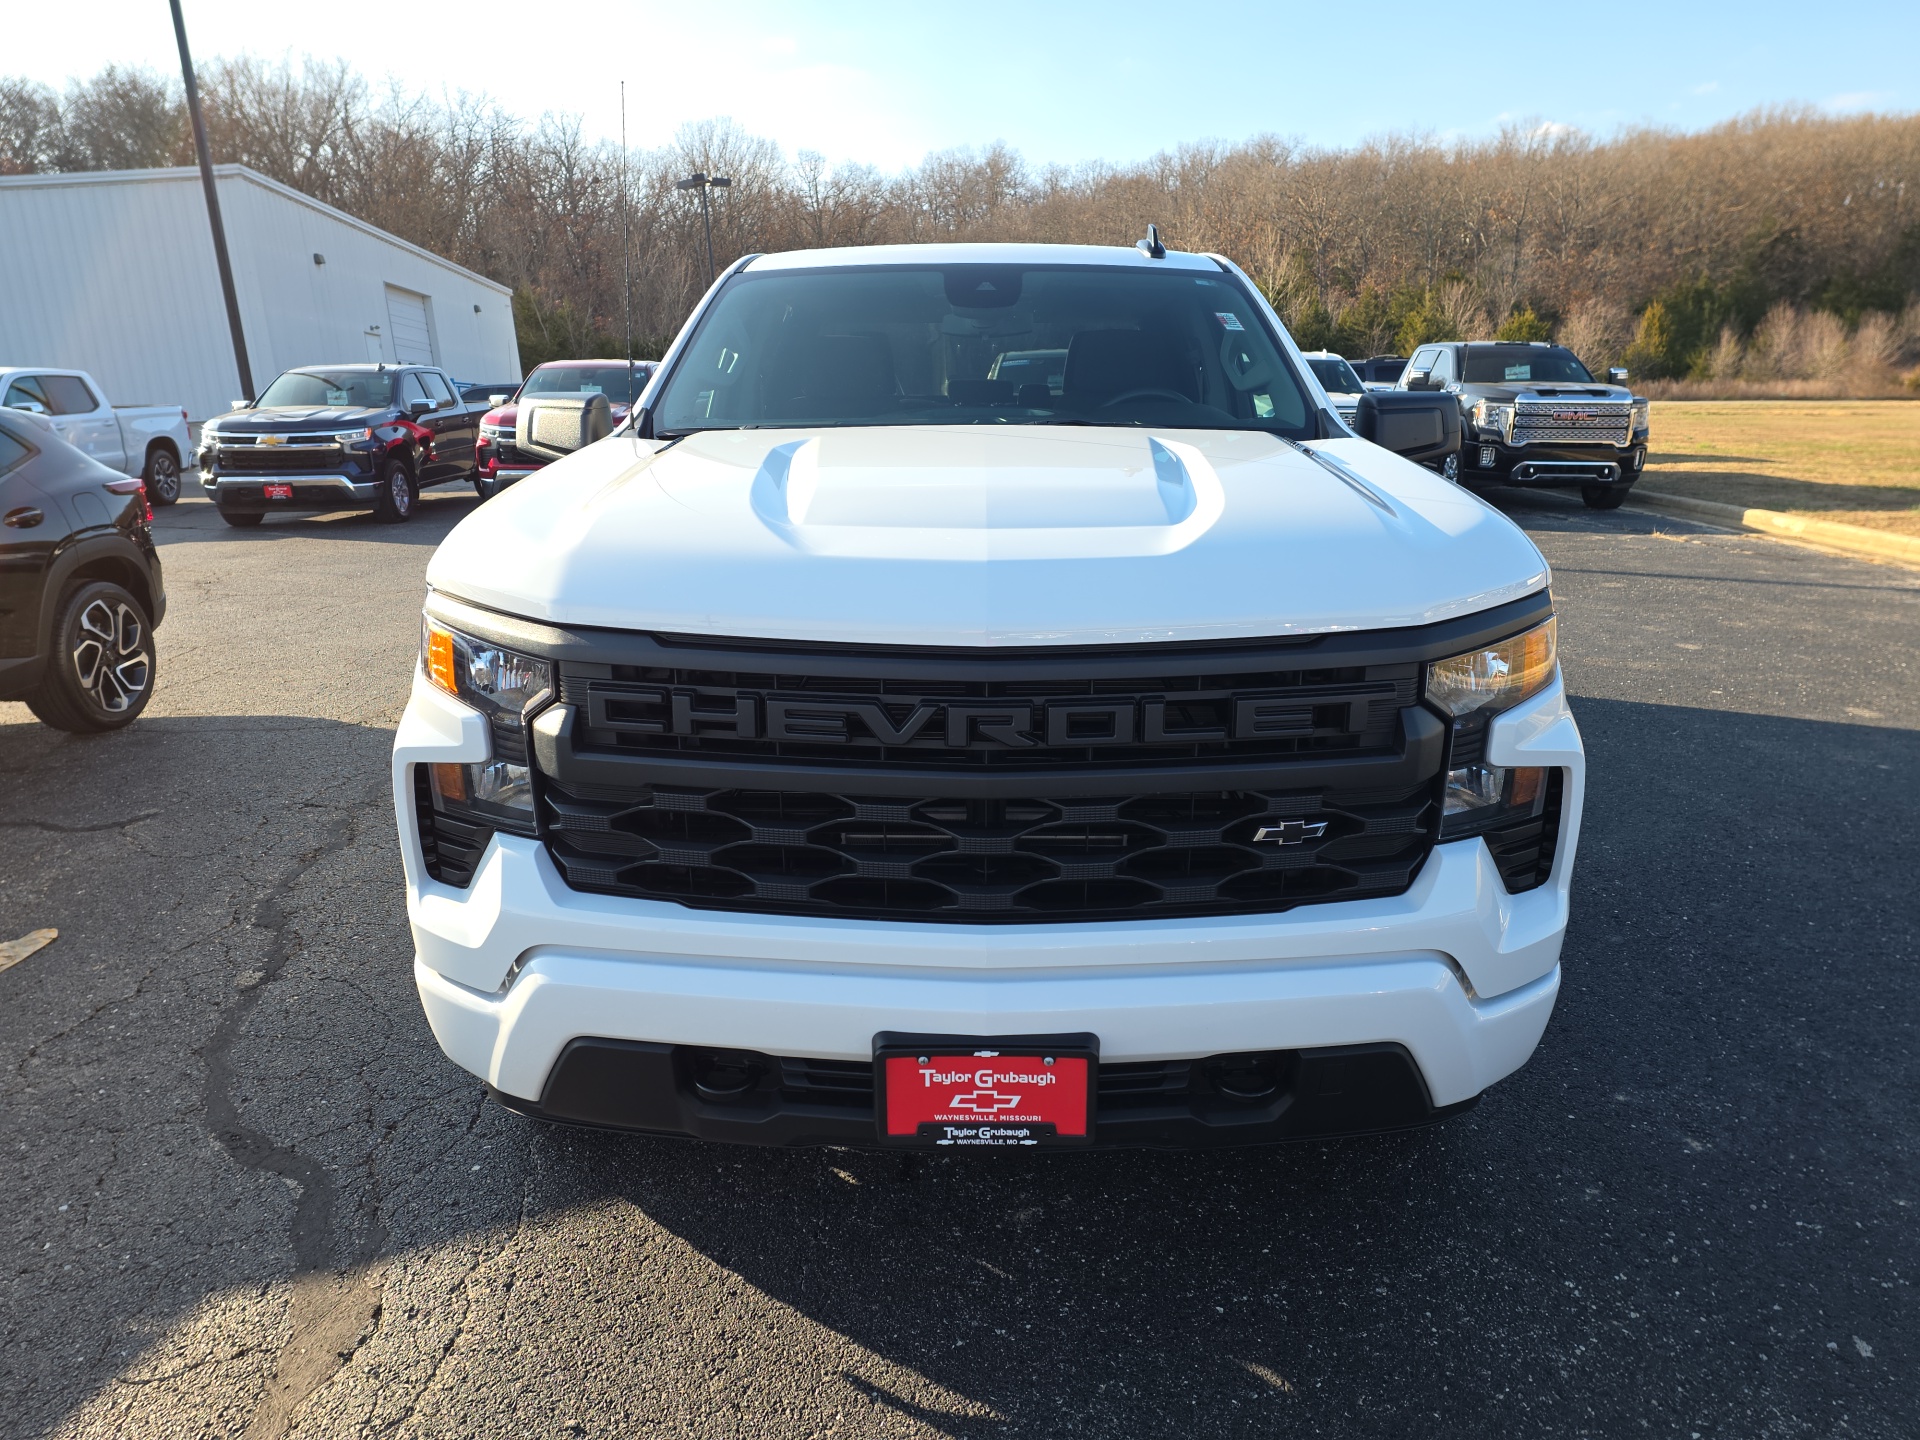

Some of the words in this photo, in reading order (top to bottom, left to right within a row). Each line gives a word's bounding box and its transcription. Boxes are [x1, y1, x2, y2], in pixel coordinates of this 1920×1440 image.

[1554, 411, 1598, 420] GMC
[587, 682, 1398, 748] CHEVROLET
[919, 1069, 971, 1087] Taylor
[974, 1069, 1056, 1087] Grubaugh
[934, 1114, 997, 1122] WAYNESVILLE,
[1000, 1114, 1042, 1122] MISSOURI
[944, 1127, 977, 1139] Taylor
[978, 1127, 1030, 1139] Grubaugh
